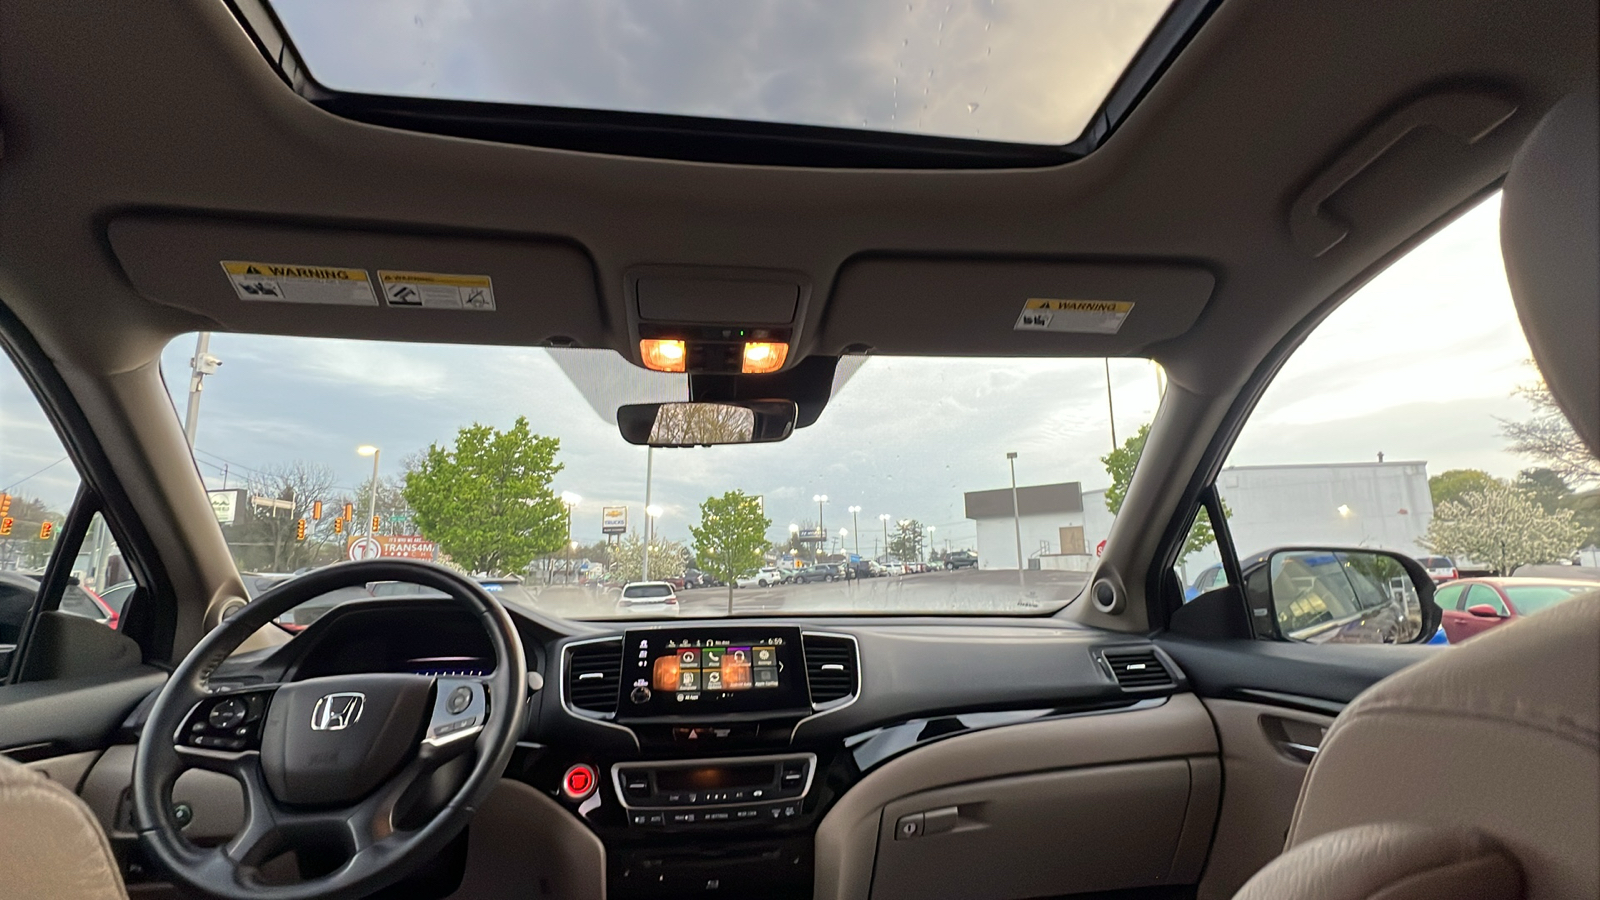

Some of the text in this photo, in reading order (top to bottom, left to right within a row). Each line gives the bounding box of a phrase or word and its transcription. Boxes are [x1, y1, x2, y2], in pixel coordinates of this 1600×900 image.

[268, 266, 349, 280] WARNING
[1058, 302, 1117, 311] WARNING
[384, 543, 435, 552] TRANS4M
[767, 638, 783, 646] 6:59
